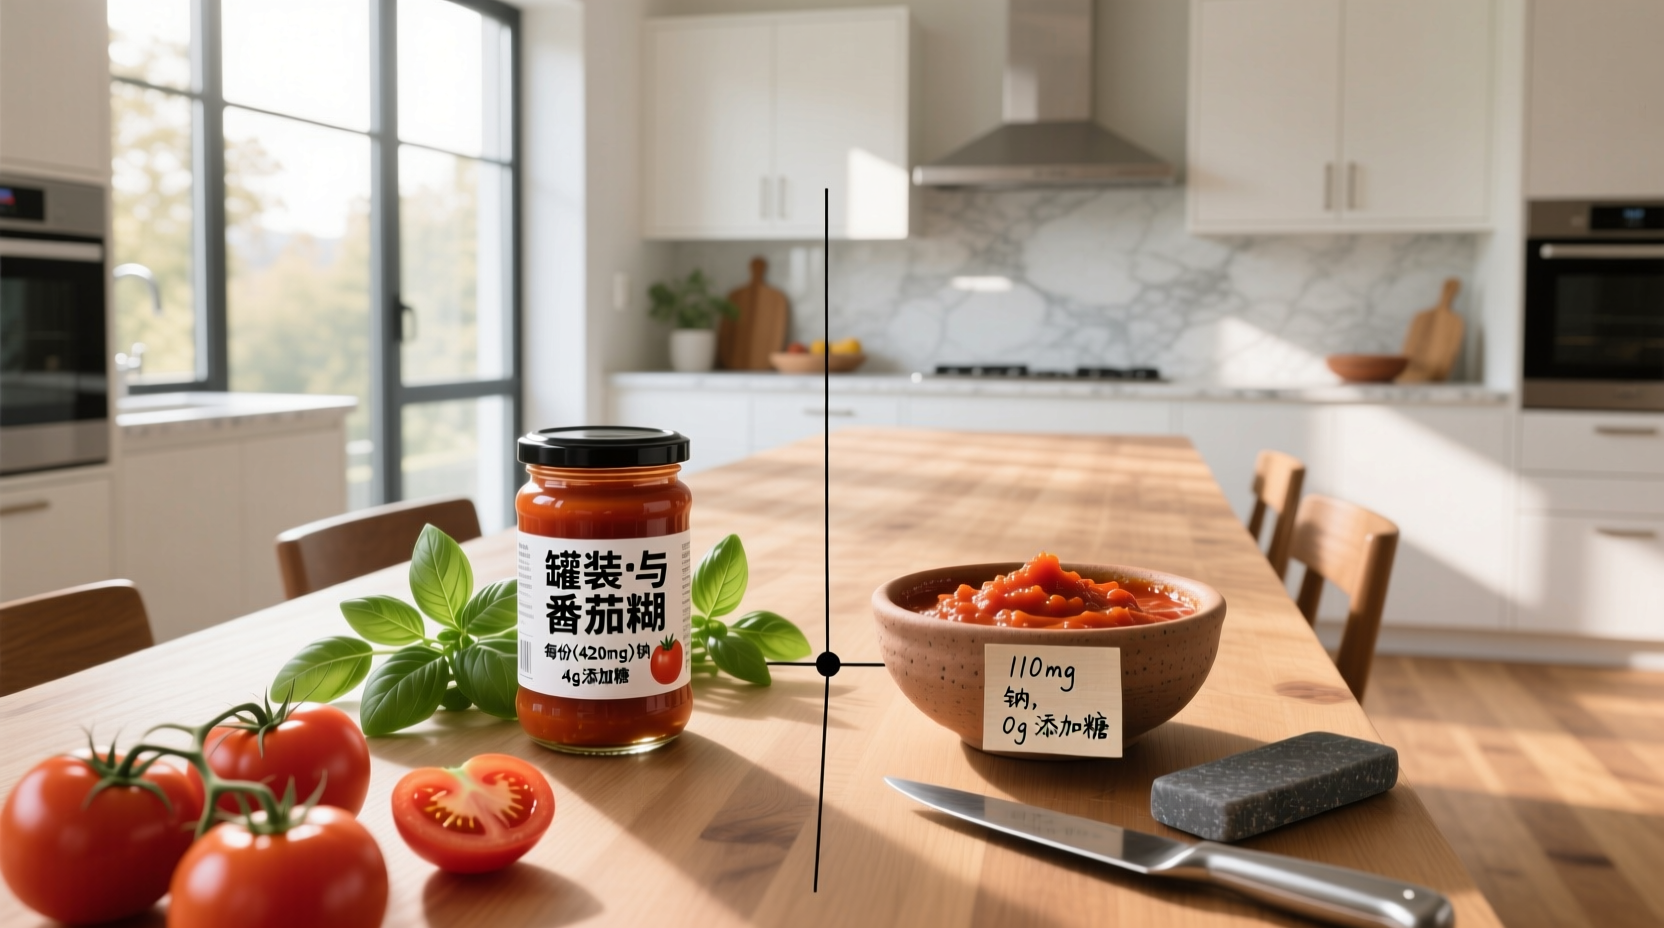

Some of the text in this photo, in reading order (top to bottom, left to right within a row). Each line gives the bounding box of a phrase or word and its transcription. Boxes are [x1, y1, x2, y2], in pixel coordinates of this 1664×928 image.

[545, 549, 668, 590] 罐装·与
[546, 591, 667, 635] 番茄糊
[1010, 655, 1076, 692] 110mg
